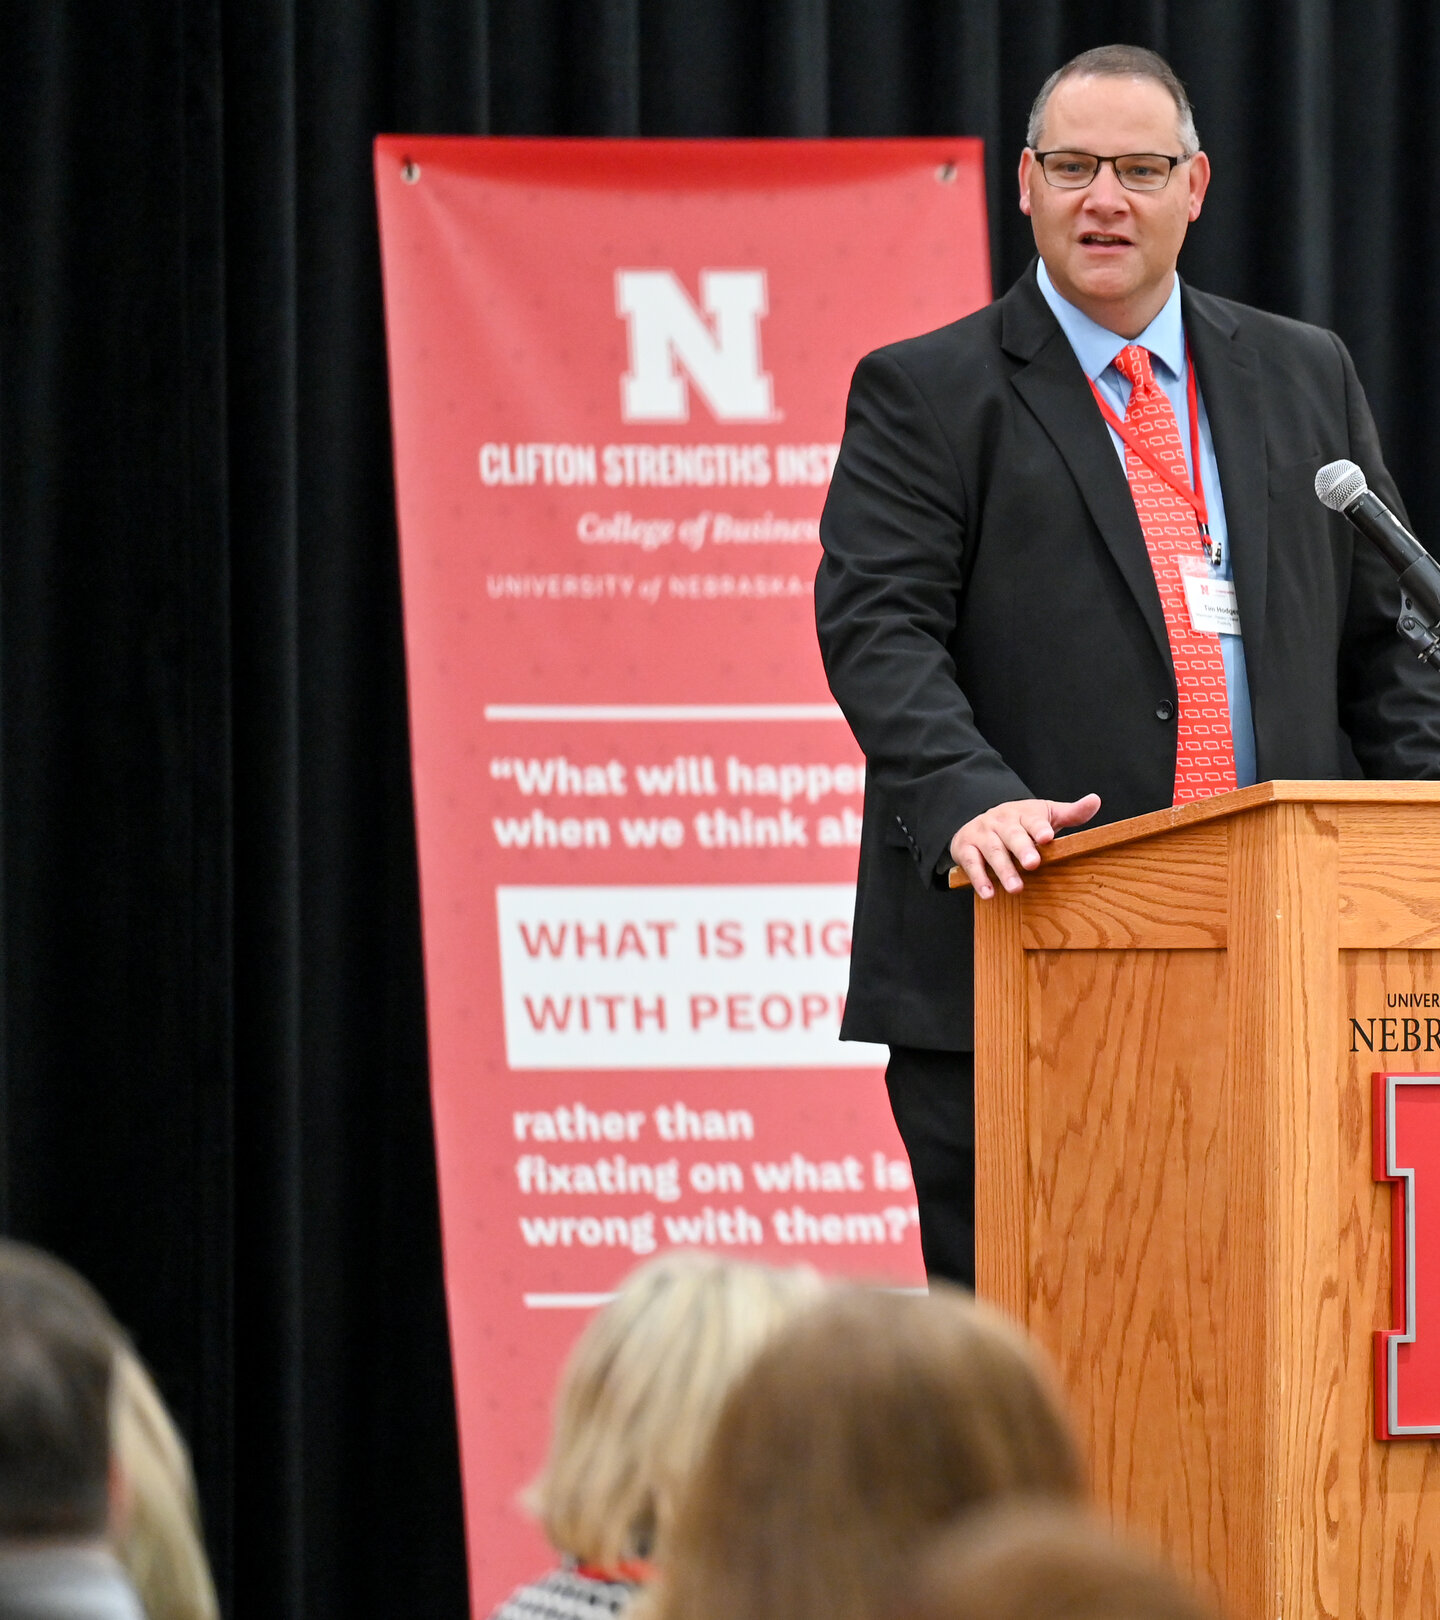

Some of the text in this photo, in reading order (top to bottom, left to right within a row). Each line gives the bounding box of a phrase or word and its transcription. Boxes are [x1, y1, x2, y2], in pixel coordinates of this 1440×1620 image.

[614, 267, 774, 424] N
[479, 442, 597, 486] CLIFTON
[602, 443, 771, 487] STRENGTHS
[576, 511, 675, 552] College
[678, 510, 711, 551] of
[486, 574, 634, 600] UNIVERSITY
[638, 576, 660, 603] of
[636, 756, 717, 796] will
[492, 808, 611, 848] when
[619, 817, 685, 848] we
[693, 808, 808, 847] think
[519, 920, 677, 960] WHAT
[697, 920, 744, 959] IS
[523, 994, 667, 1033] WITH
[513, 1101, 754, 1142] rather than
[516, 1151, 911, 1202] fixating on what is
[519, 1210, 657, 1255] wrong
[662, 1204, 763, 1245] with
